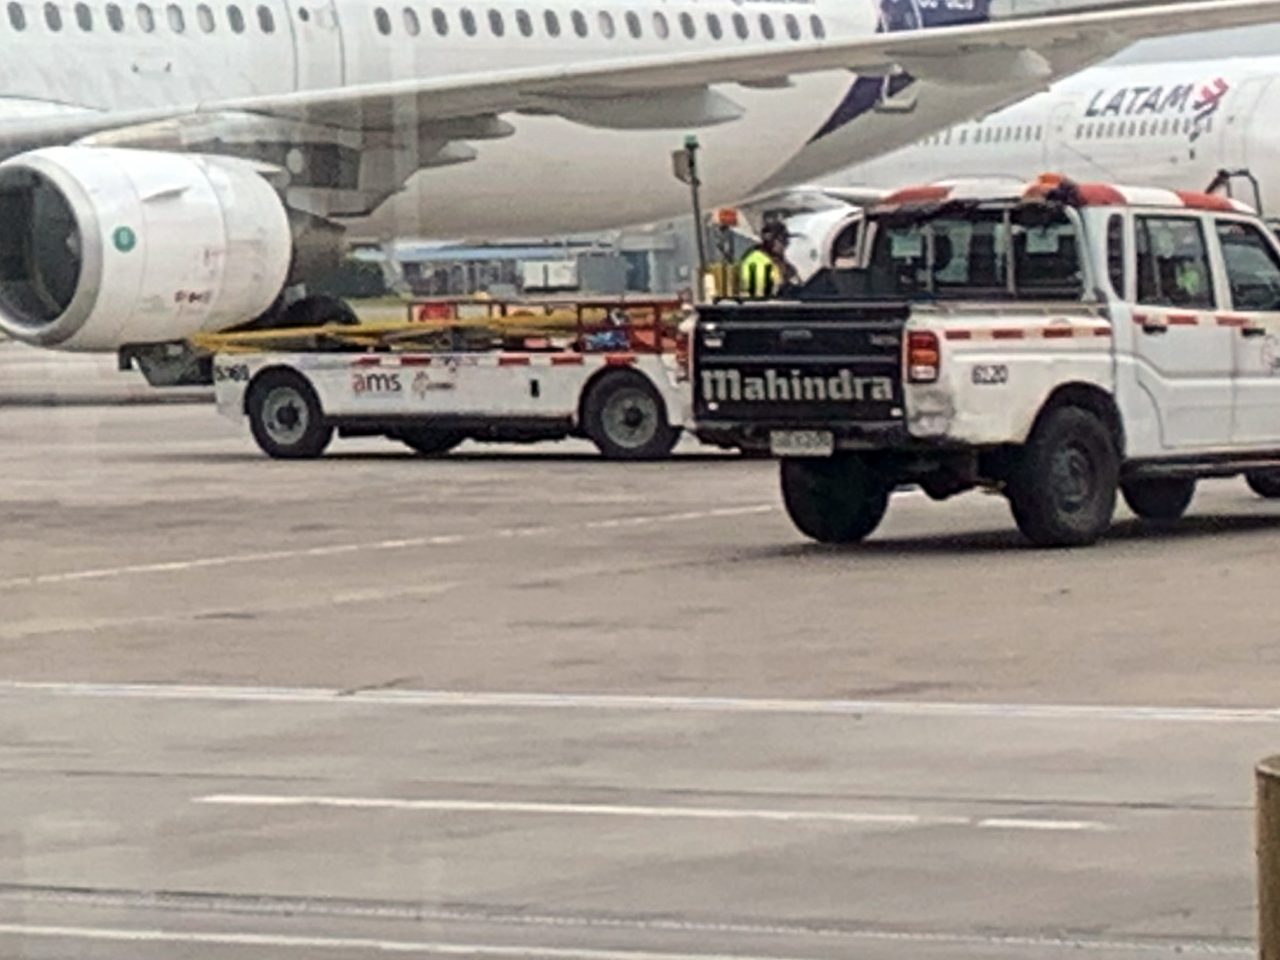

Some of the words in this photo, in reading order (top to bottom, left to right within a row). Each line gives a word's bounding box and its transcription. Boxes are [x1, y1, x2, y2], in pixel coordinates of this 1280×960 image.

[1085, 83, 1195, 118] LATAM
[352, 372, 403, 394] ams
[700, 368, 895, 401] Mahindra
